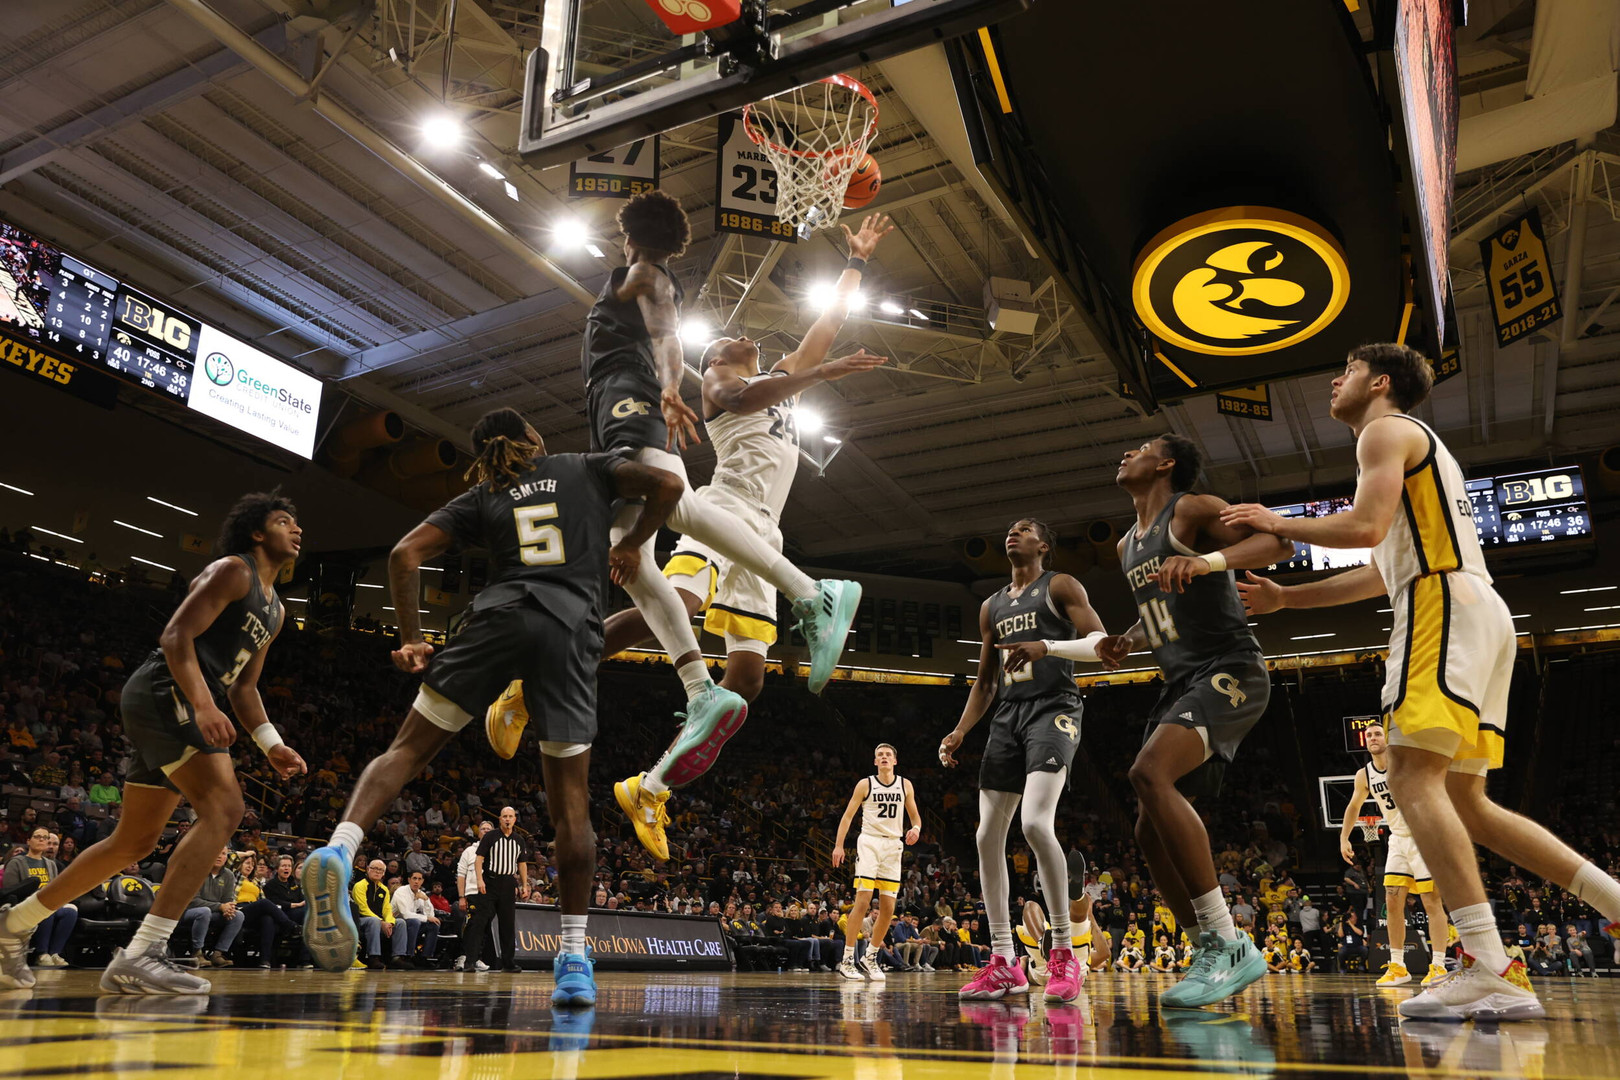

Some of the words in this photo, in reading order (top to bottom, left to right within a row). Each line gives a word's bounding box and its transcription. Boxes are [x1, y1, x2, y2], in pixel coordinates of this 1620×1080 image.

[576, 178, 655, 195] 1950-52
[732, 164, 778, 205] 23
[720, 213, 793, 237] 1986-89
[1503, 251, 1529, 271] GARZA
[83, 268, 96, 279] GT
[1499, 259, 1545, 310] 55
[62, 278, 69, 287] 3
[87, 291, 95, 299] 7
[103, 299, 110, 308] 2
[56, 304, 64, 313] 5
[80, 315, 92, 325] 10
[59, 291, 66, 300] 4
[84, 303, 92, 312] 2
[100, 311, 108, 320] 2
[51, 317, 63, 328] 13
[79, 330, 86, 339] 8
[1501, 302, 1558, 341] 2018-21
[48, 331, 60, 343] 14
[76, 344, 83, 353] 4
[92, 351, 100, 360] 3
[114, 347, 131, 362] 40
[137, 356, 166, 377] 17:46
[171, 372, 187, 388] 36
[141, 377, 155, 388] 2ND
[237, 369, 312, 414] GreenState
[208, 388, 245, 414] Creating
[247, 406, 276, 428] Lasting
[279, 419, 300, 436] Value
[1220, 398, 1270, 416] 1982-85
[767, 407, 798, 447] 24
[509, 478, 558, 501] SMITH
[1486, 495, 1493, 503] 2
[1473, 506, 1480, 514] 2
[1488, 504, 1494, 512] 2
[1473, 516, 1483, 524] 10
[513, 502, 566, 566] 5
[1509, 522, 1525, 533] 40
[1530, 518, 1562, 530] 17:46
[1567, 515, 1584, 527] 36
[1126, 555, 1161, 592] TECH
[1267, 563, 1277, 571] 30
[241, 611, 271, 650] TECH
[996, 611, 1038, 640] TECH
[1139, 597, 1180, 649] 14
[872, 793, 902, 802] IOWA
[1380, 793, 1396, 810] 3
[877, 803, 898, 818] 20
[518, 931, 598, 953] UNIVTY
[611, 934, 648, 955] IOWA
[646, 937, 695, 956] HEALTH
[694, 939, 723, 956] CARE
